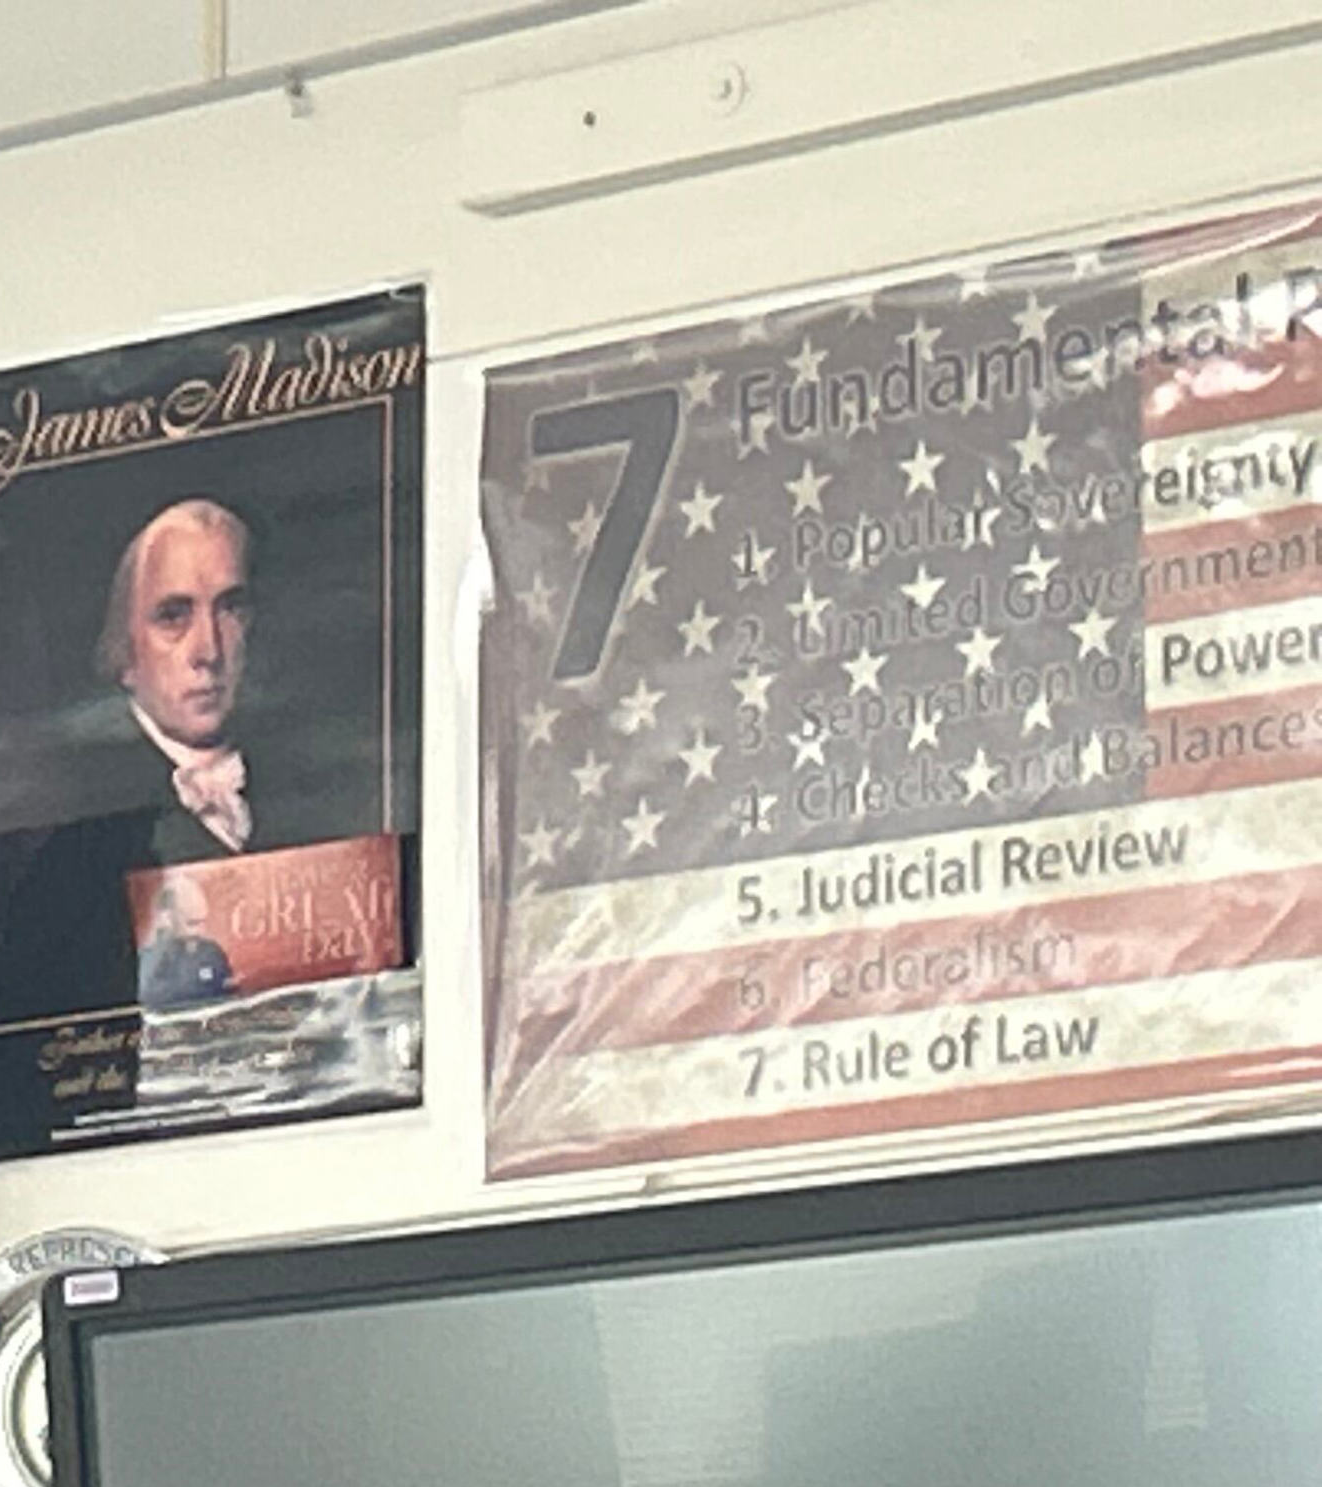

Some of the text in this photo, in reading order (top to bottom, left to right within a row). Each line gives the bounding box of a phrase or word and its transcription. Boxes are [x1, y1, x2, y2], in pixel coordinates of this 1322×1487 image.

[159, 331, 421, 440] Madison
[528, 386, 680, 688] 7
[735, 271, 1250, 448] Fundamental
[793, 498, 985, 571] Popular
[1005, 439, 1315, 536] Sovereignty
[794, 584, 984, 658] Limited
[799, 666, 1072, 740] Separation
[795, 758, 962, 822] Checks
[986, 734, 1082, 788] and
[736, 822, 1189, 926] 5. Judicial Review
[801, 925, 1077, 1001] Federalism
[737, 1012, 1100, 1097] 7. Rule of Law
